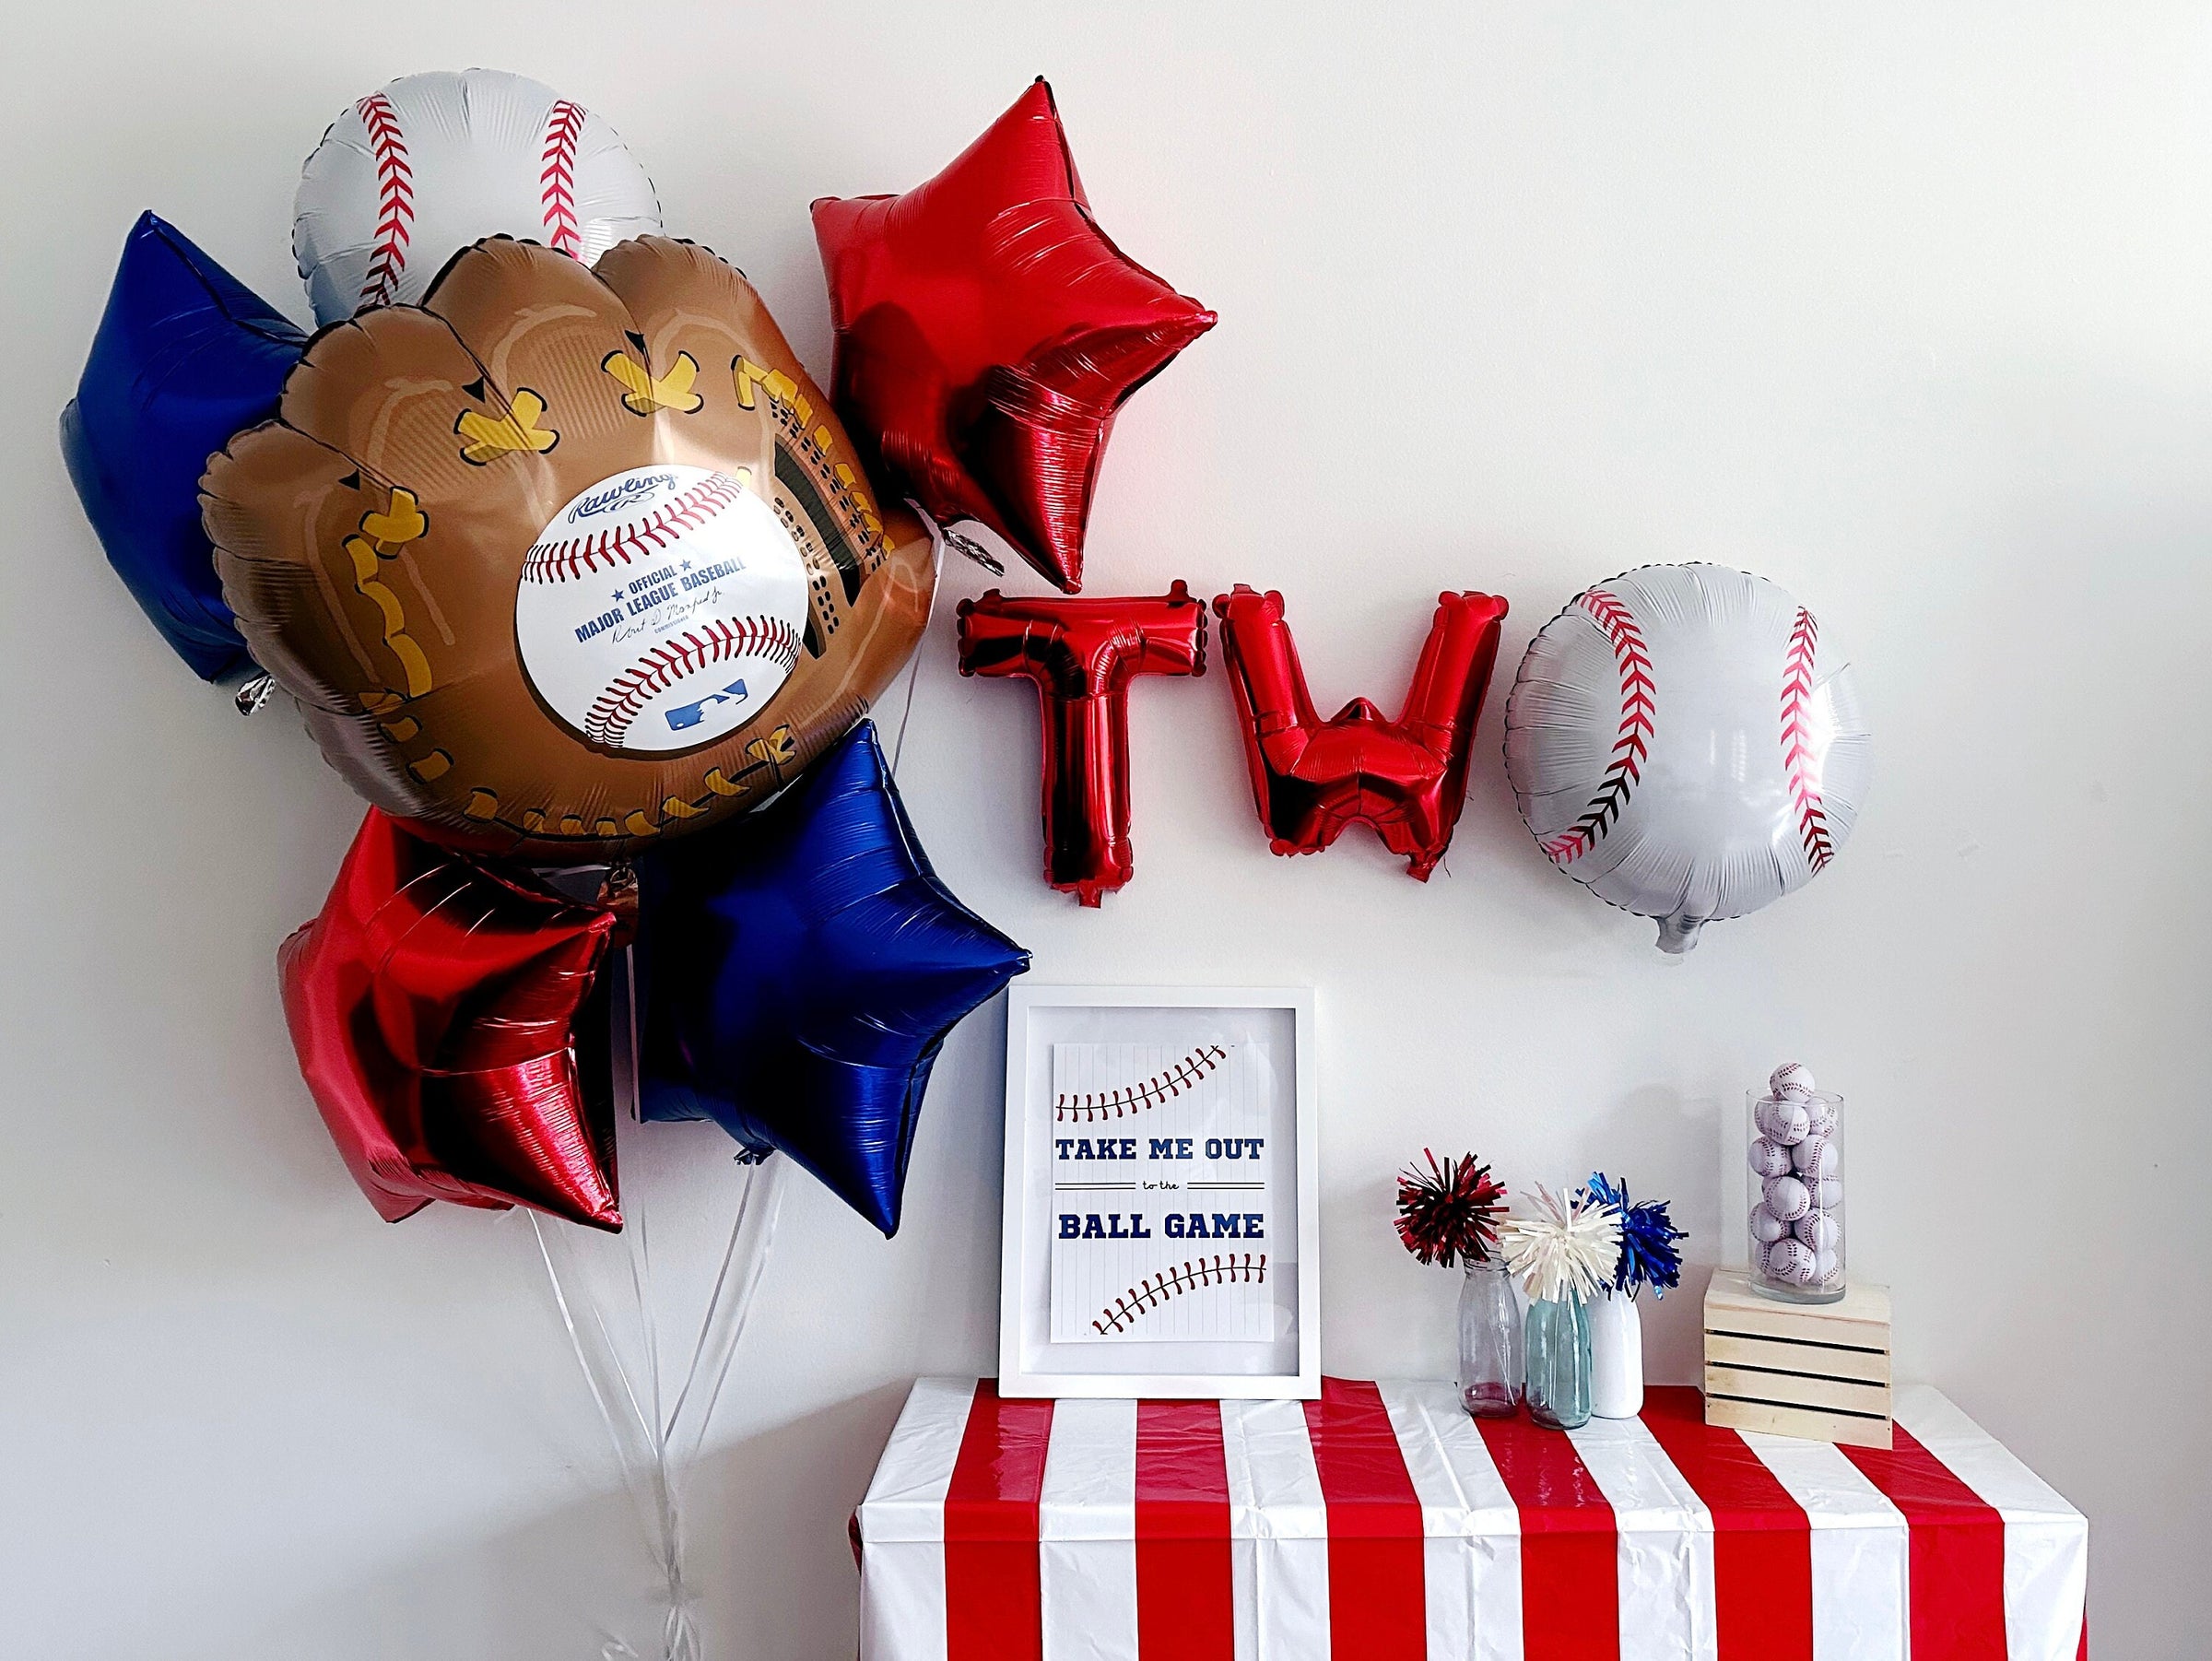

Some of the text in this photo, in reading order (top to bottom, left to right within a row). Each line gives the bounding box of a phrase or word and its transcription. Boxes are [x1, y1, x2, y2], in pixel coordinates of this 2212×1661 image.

[628, 564, 678, 595] OFFICIAL
[574, 556, 747, 643] MAJOR LEAGUE BASEBALL
[1055, 1138, 1265, 1160] TAKE ME OUT
[1143, 1180, 1180, 1191] to the
[1059, 1213, 1265, 1239] BALL GAME
